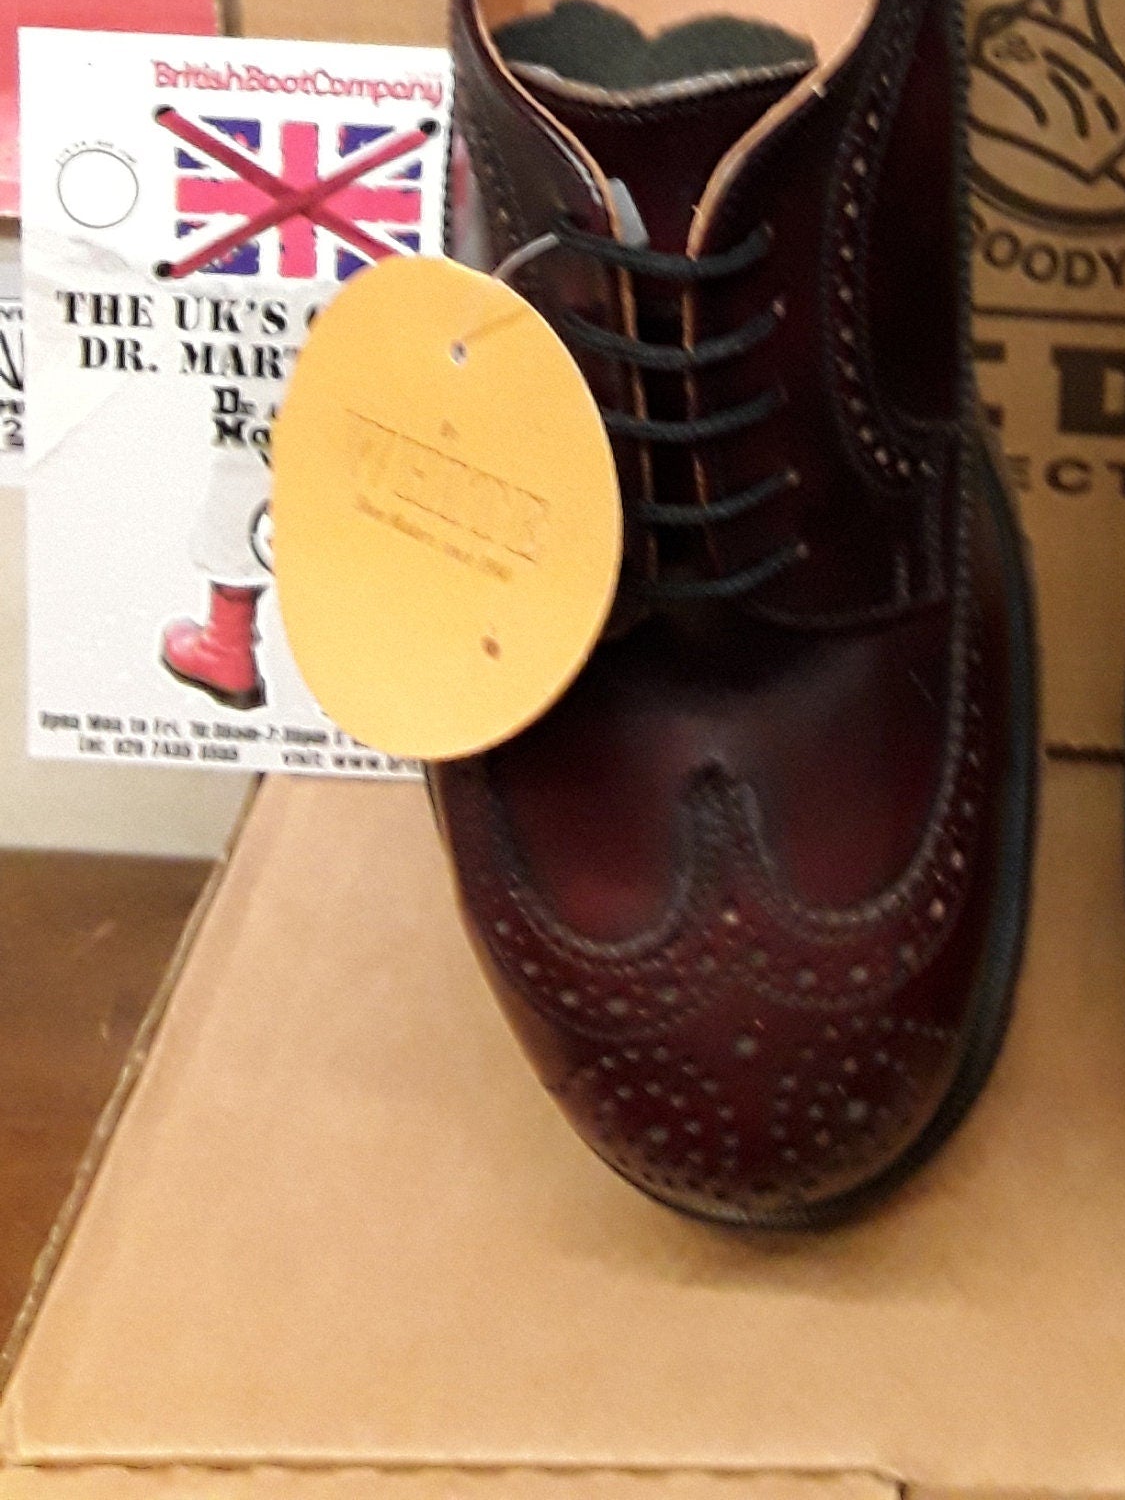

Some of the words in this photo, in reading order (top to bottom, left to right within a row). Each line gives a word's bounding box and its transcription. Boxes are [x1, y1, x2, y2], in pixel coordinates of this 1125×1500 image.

[56, 289, 154, 329] THE
[171, 294, 290, 336] UK'S
[78, 334, 159, 373] DR.
